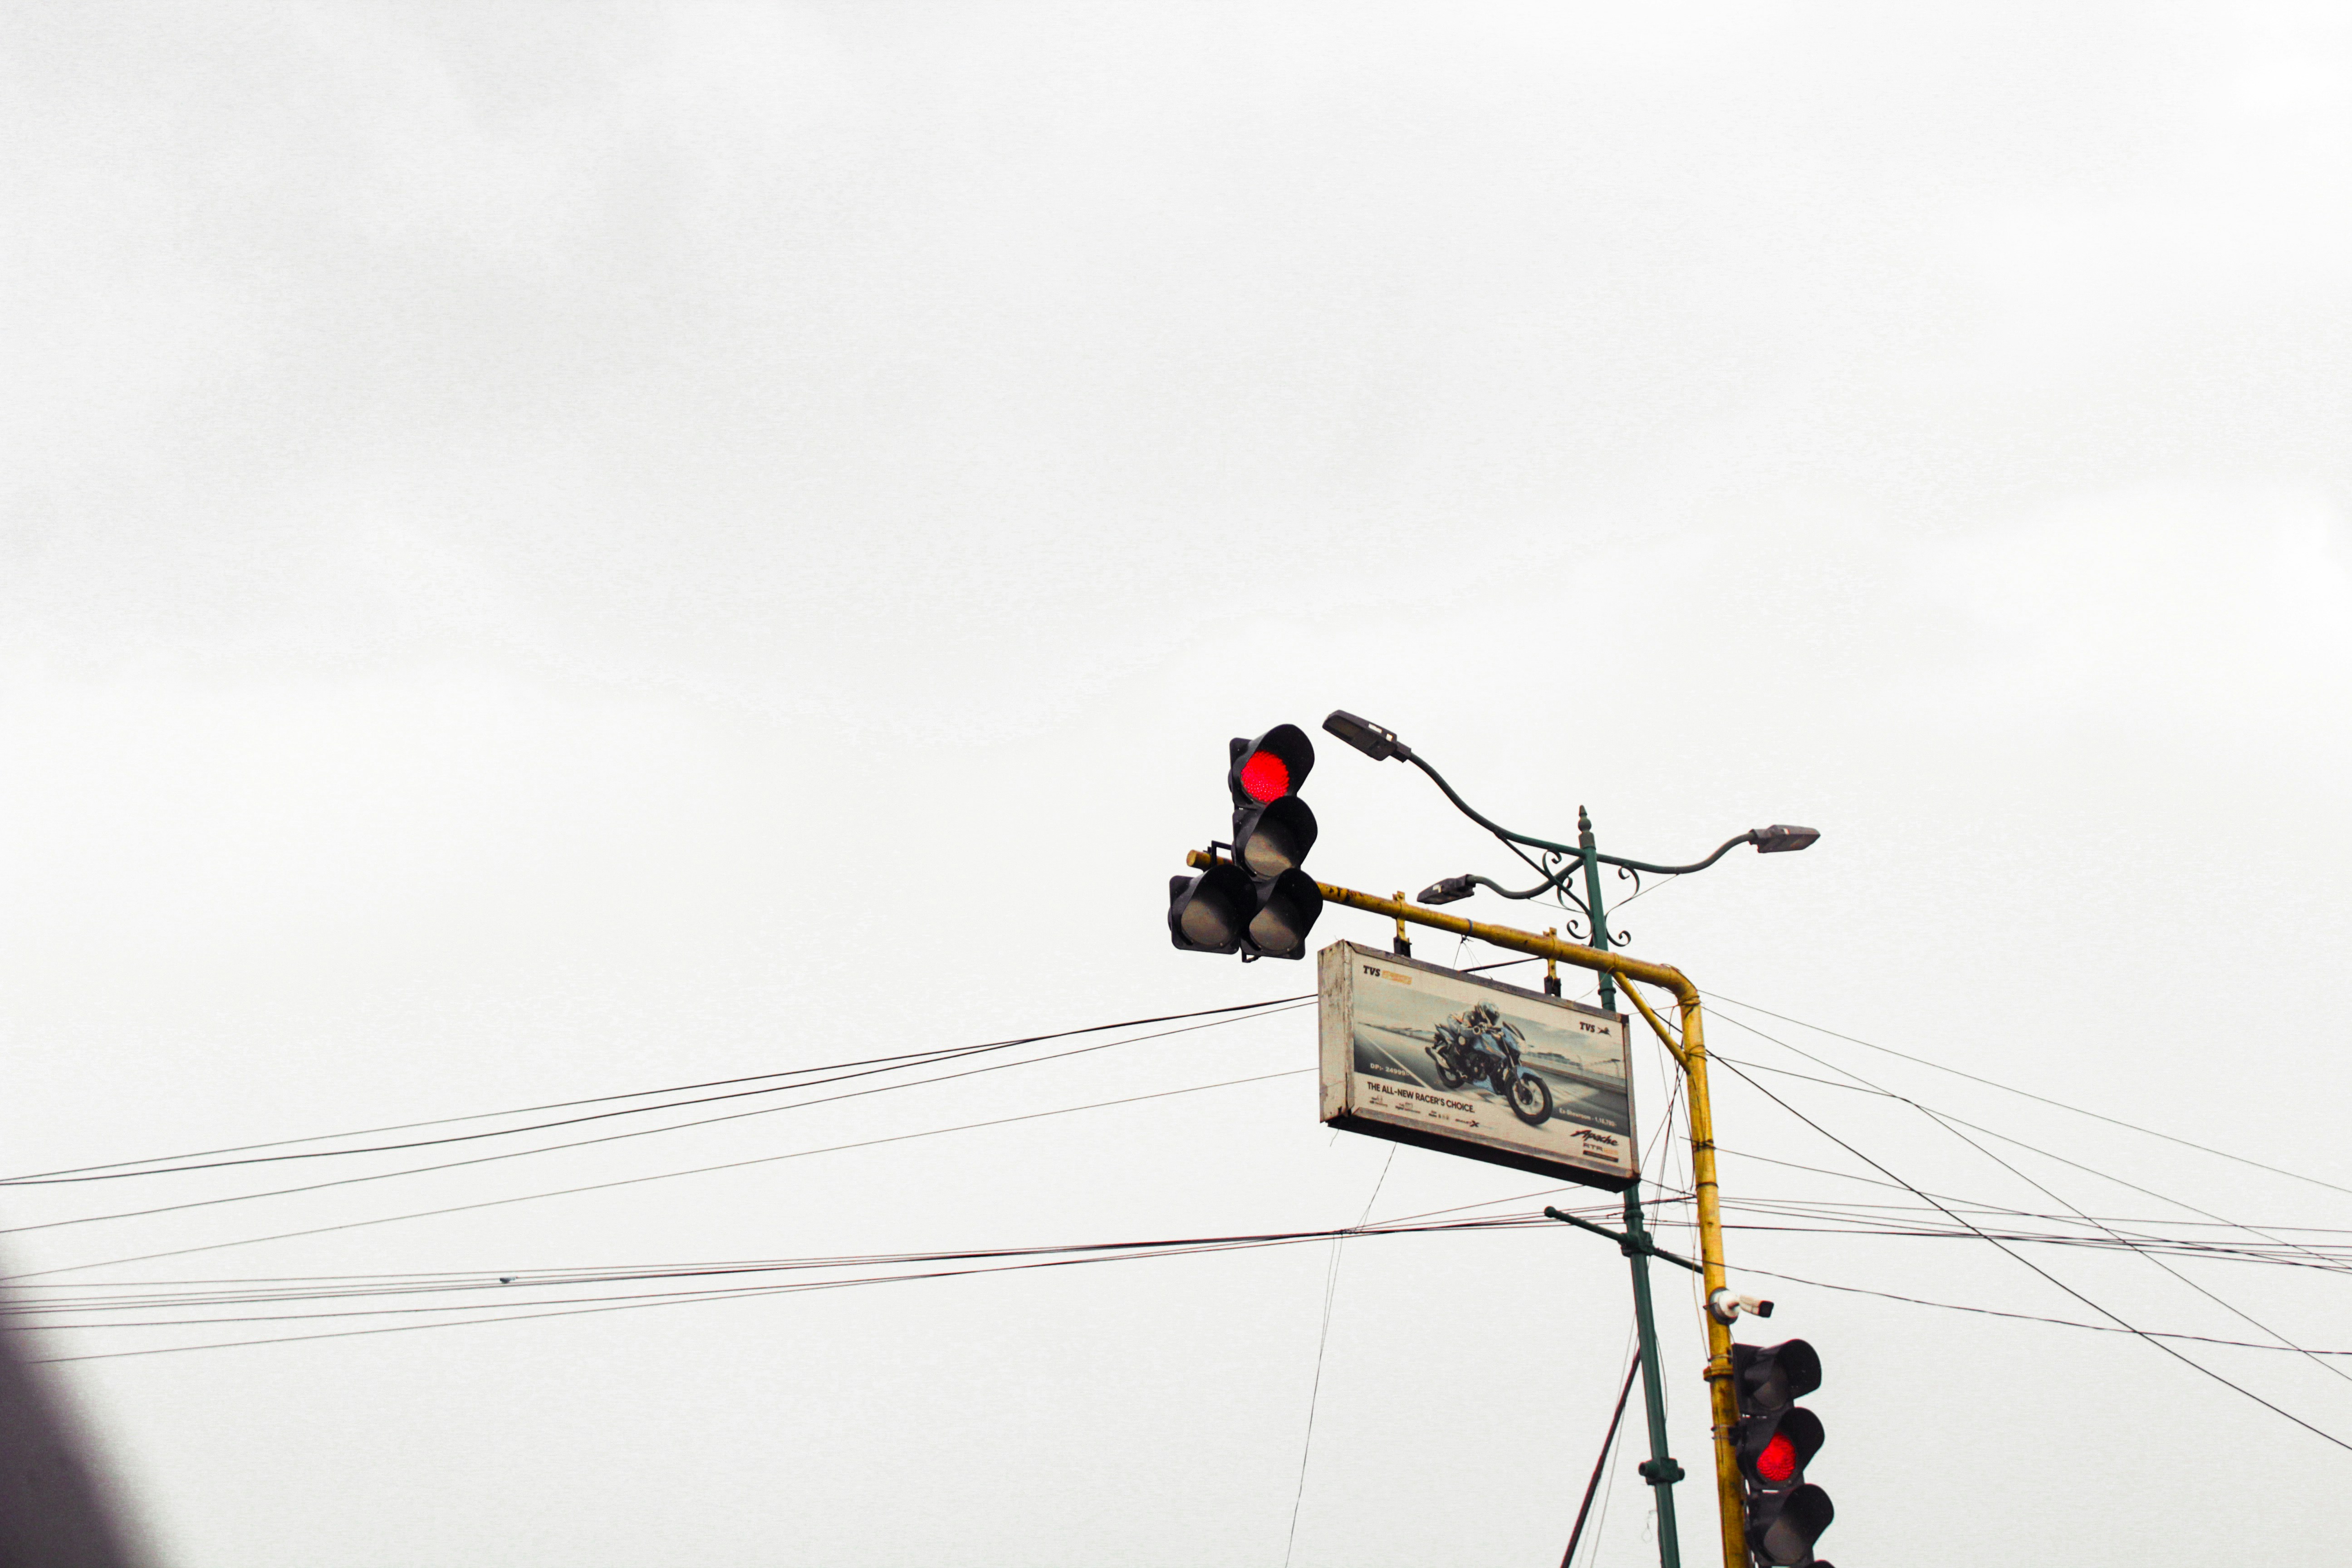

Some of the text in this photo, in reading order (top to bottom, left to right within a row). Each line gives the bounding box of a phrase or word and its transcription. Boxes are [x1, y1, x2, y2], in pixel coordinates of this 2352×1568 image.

[1363, 965, 1381, 977] TVS
[1579, 1021, 1595, 1033] TVS
[1367, 1081, 1475, 1113] THE ALL-NEW RACER'S CHOICE.
[1570, 1129, 1619, 1146] Apache
[1583, 1142, 1603, 1152] RTR
